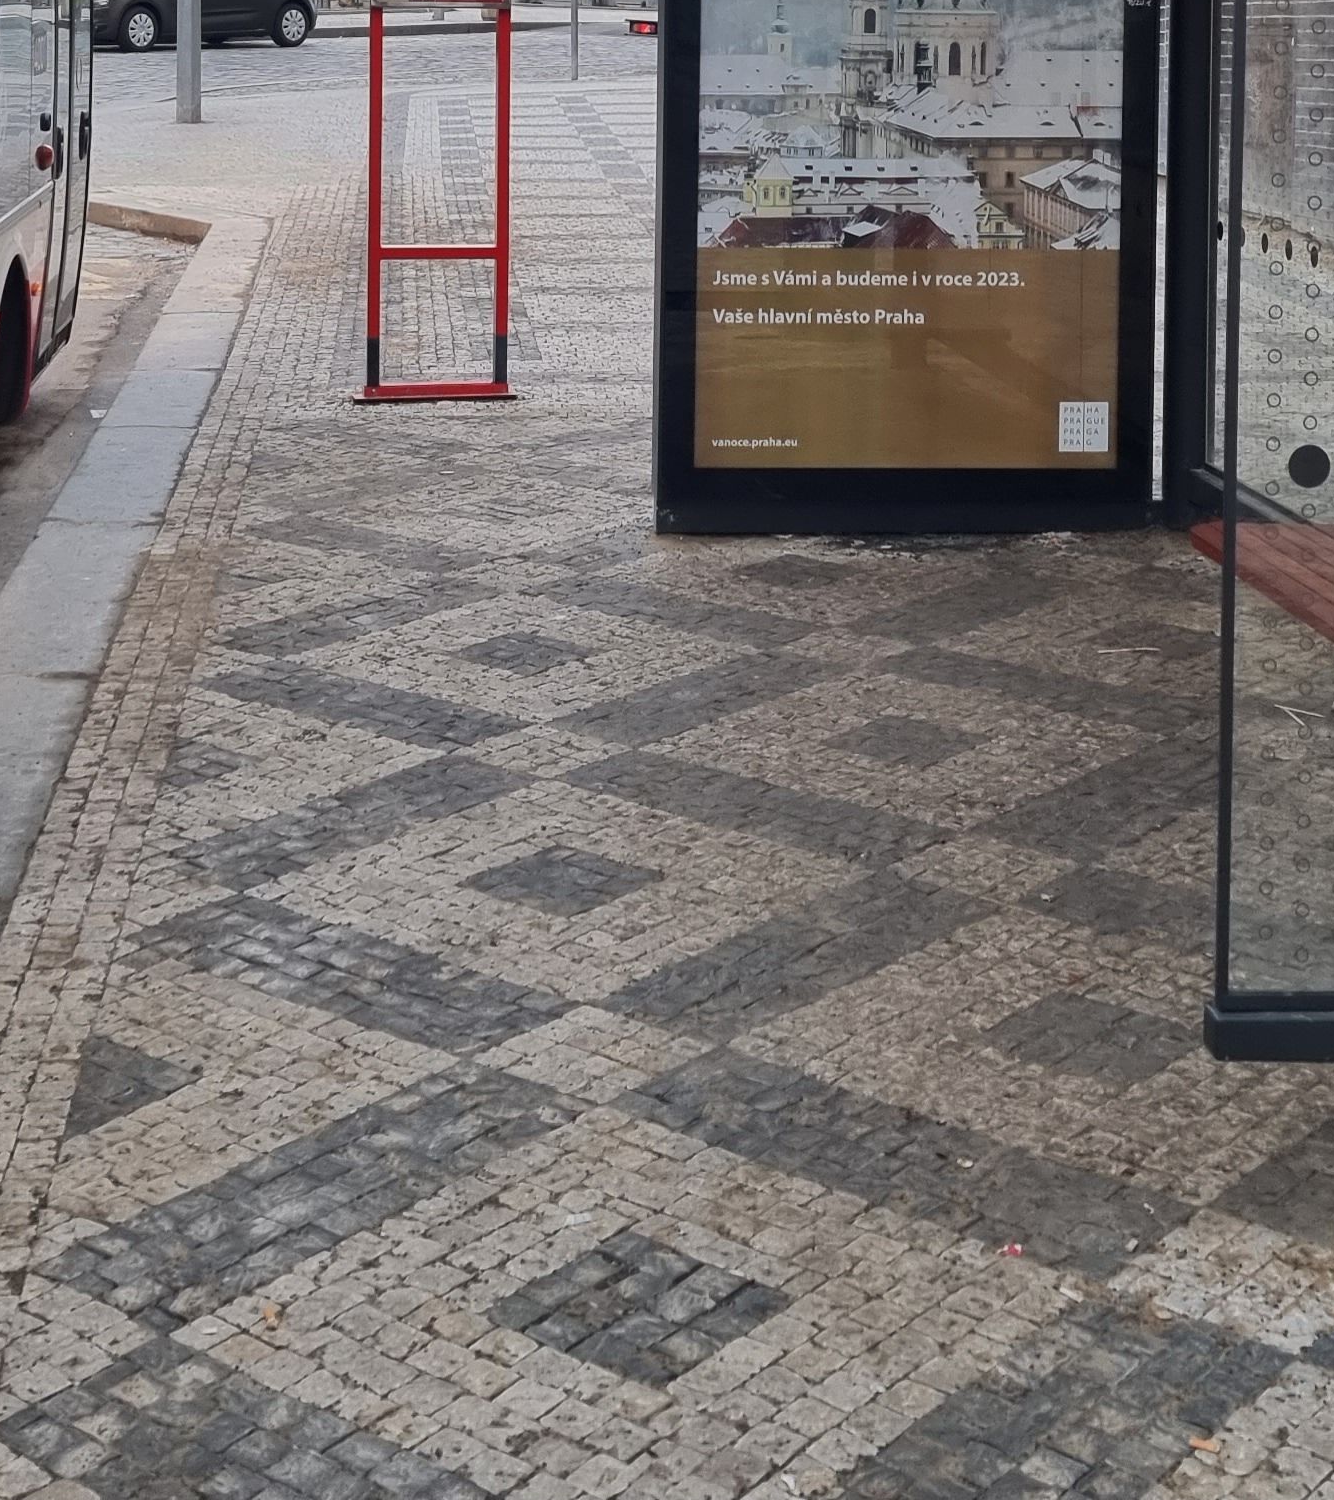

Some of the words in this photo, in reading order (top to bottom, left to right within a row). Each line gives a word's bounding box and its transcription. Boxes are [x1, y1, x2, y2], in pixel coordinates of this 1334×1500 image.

[712, 270, 757, 286] Jsme
[761, 274, 770, 286] s
[773, 270, 817, 286] Vámi
[821, 274, 832, 286] a
[836, 270, 908, 286] budeme
[912, 270, 917, 286] i
[921, 274, 932, 286] v
[935, 274, 973, 286] roce
[976, 271, 1025, 287] 2023.
[712, 308, 754, 324] Vaše
[758, 308, 813, 324] hlavní
[816, 308, 870, 324] město
[874, 308, 925, 324] Praha
[712, 436, 798, 449] vanoce.praha.eu
